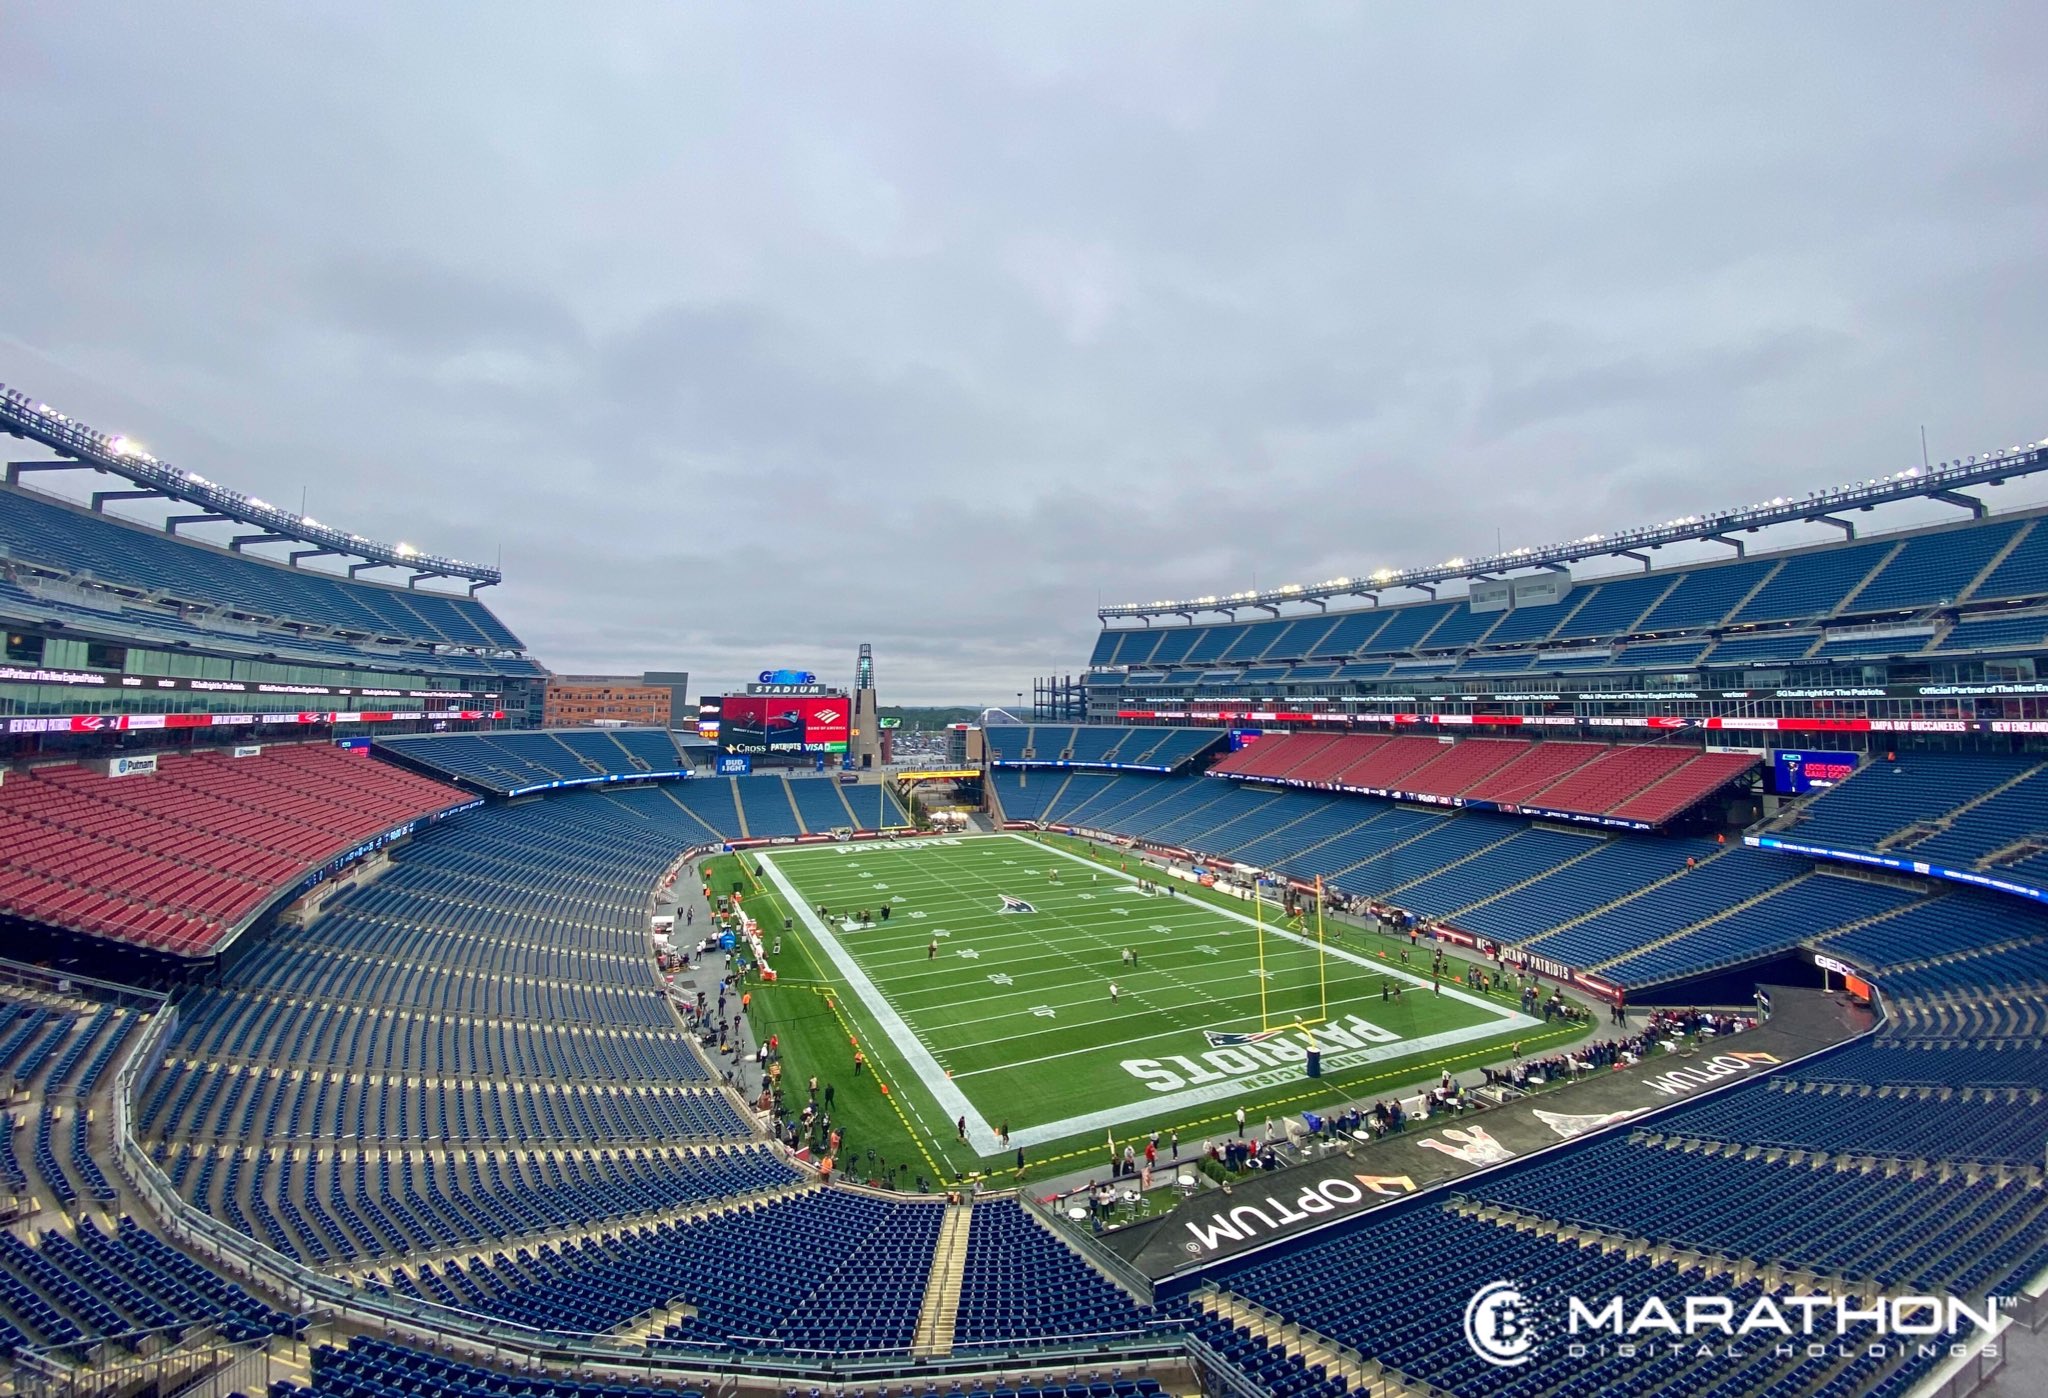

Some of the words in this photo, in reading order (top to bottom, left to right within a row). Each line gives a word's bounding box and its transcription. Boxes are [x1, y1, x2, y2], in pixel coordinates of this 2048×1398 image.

[1995, 685, 2013, 693] The
[2014, 684, 2035, 692] New
[1894, 721, 1909, 730] BAY
[1911, 721, 1965, 731] BUCCANEERS
[1992, 722, 2010, 732] NEW
[128, 760, 154, 770] Putnam
[722, 764, 746, 772] LIGHT
[1806, 763, 1826, 771] LOOK
[1827, 764, 1852, 772] GOOD
[1805, 770, 1827, 778] GAME
[836, 837, 962, 855] PATRIOTS
[1530, 955, 1568, 980] PATRIOTS
[1120, 1014, 1402, 1092] PATRIOTS
[1642, 1055, 1751, 1095] OPTUM
[1185, 1178, 1363, 1251] OPTUM
